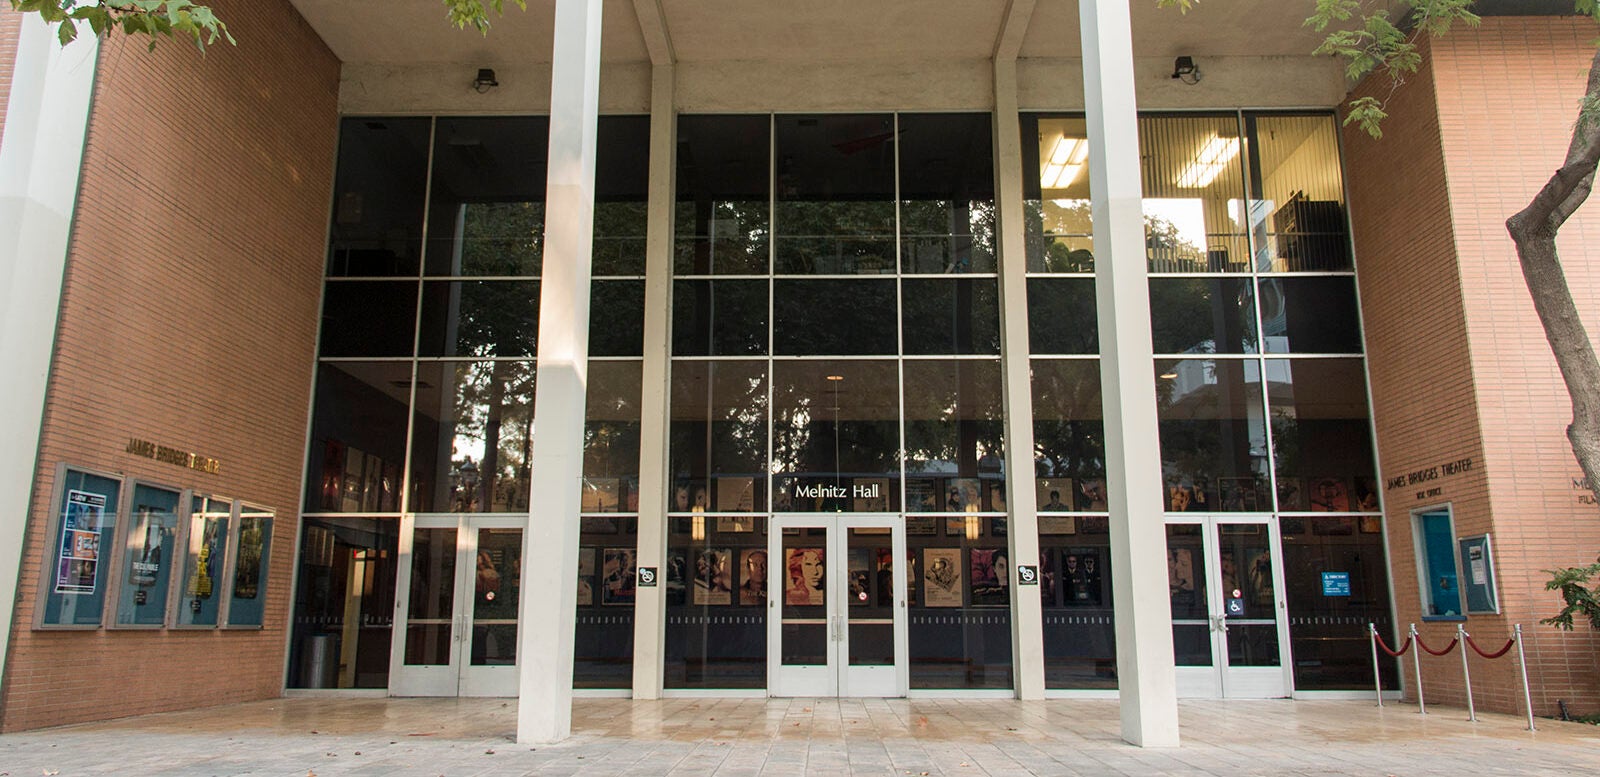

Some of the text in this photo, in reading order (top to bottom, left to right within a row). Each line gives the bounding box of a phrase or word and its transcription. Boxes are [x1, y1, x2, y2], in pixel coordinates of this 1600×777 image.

[126, 438, 155, 459] JAMES
[156, 445, 188, 467] BRIDGES
[1388, 458, 1472, 490] JAMES BRIDGES THEATER
[795, 484, 879, 498] Melnitz Hall
